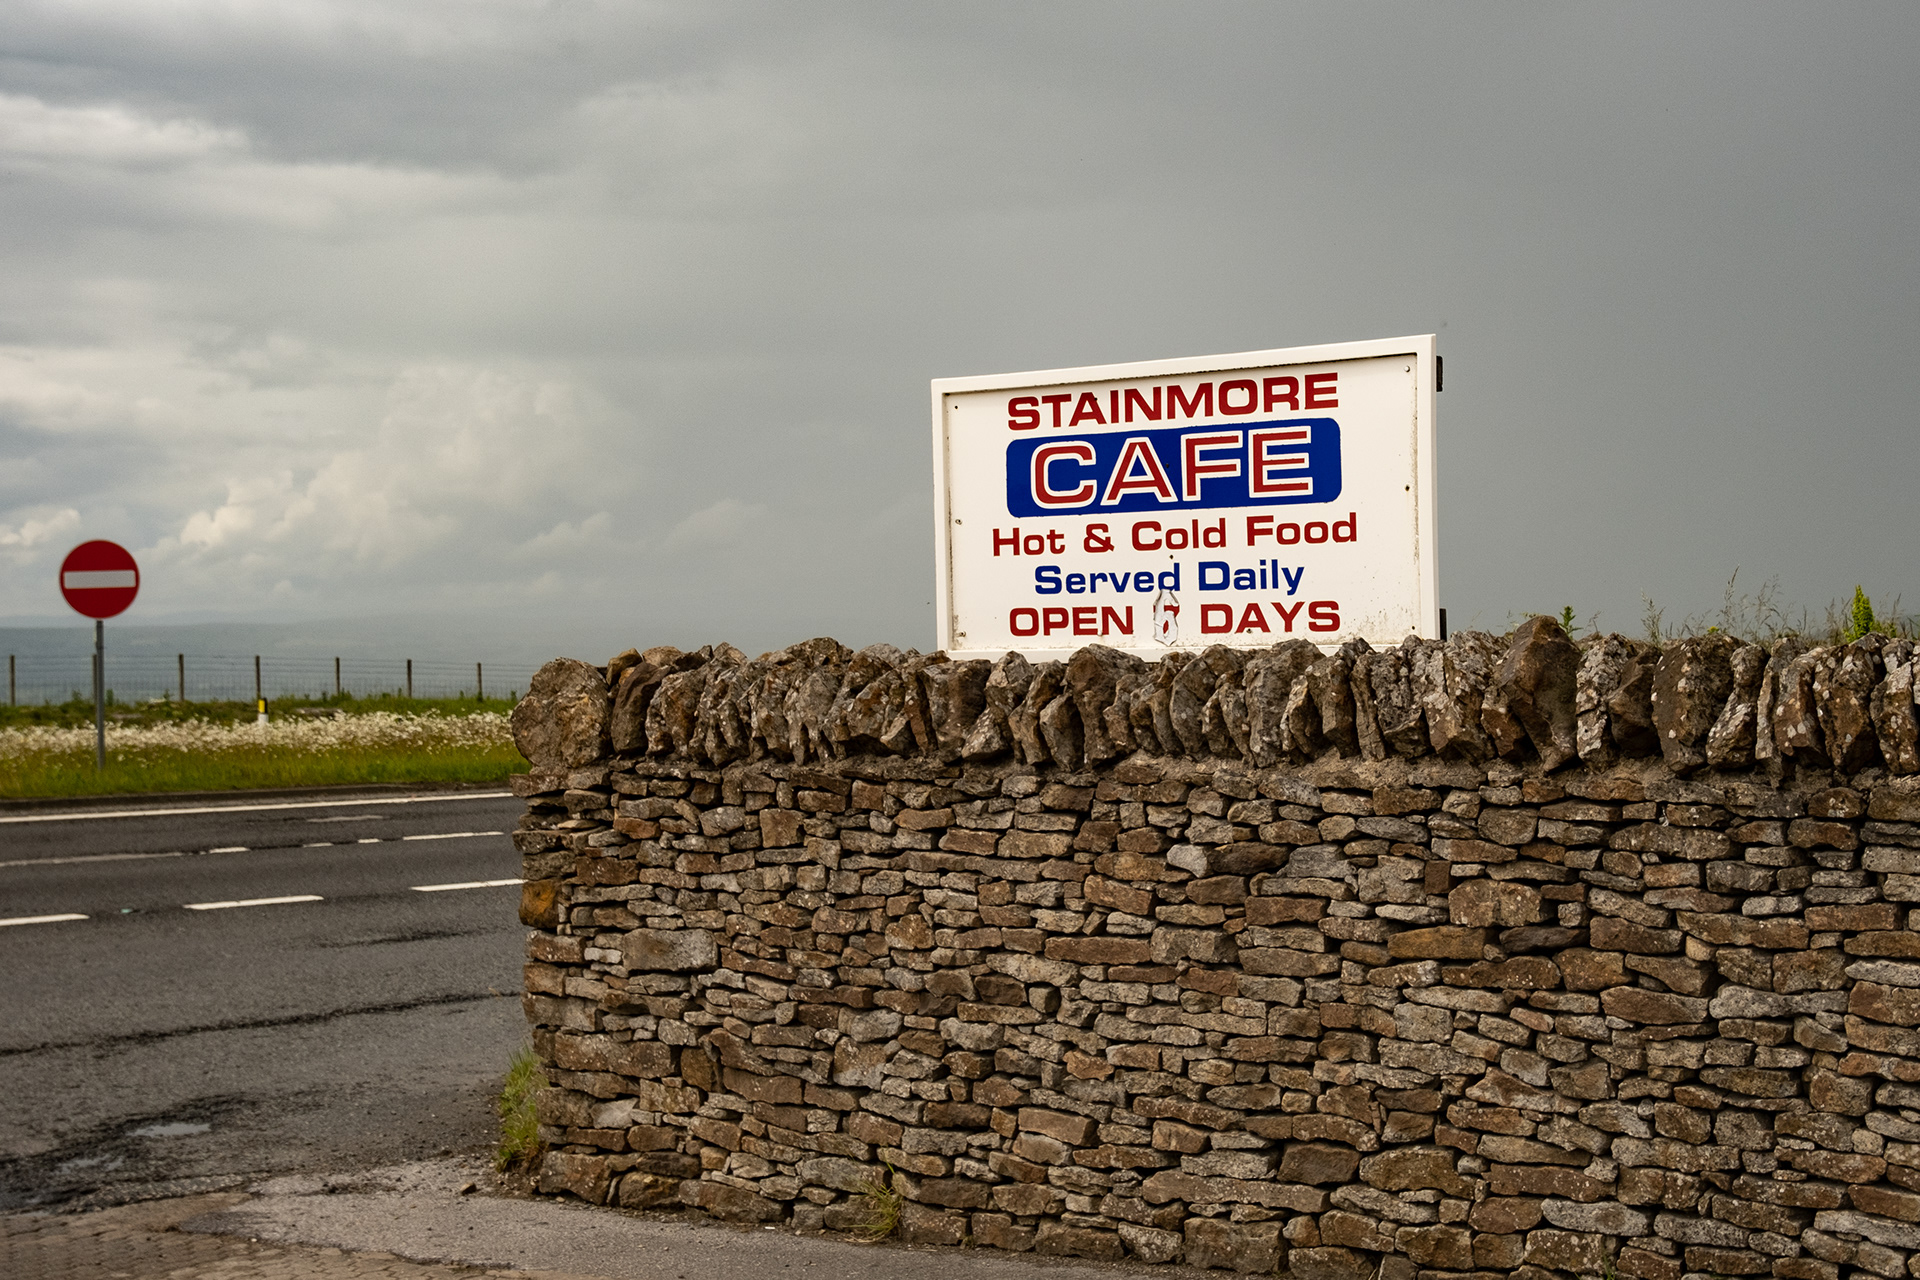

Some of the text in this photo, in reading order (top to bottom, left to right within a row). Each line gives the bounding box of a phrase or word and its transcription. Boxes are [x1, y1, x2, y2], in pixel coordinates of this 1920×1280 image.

[1008, 372, 1339, 431] STAINMORE
[1031, 425, 1313, 509] CAFE
[993, 512, 1357, 556] Hot & Cold Food
[1034, 559, 1304, 595] Served Daily
[1009, 606, 1133, 636] OPEN
[1201, 600, 1341, 633] DAYS
